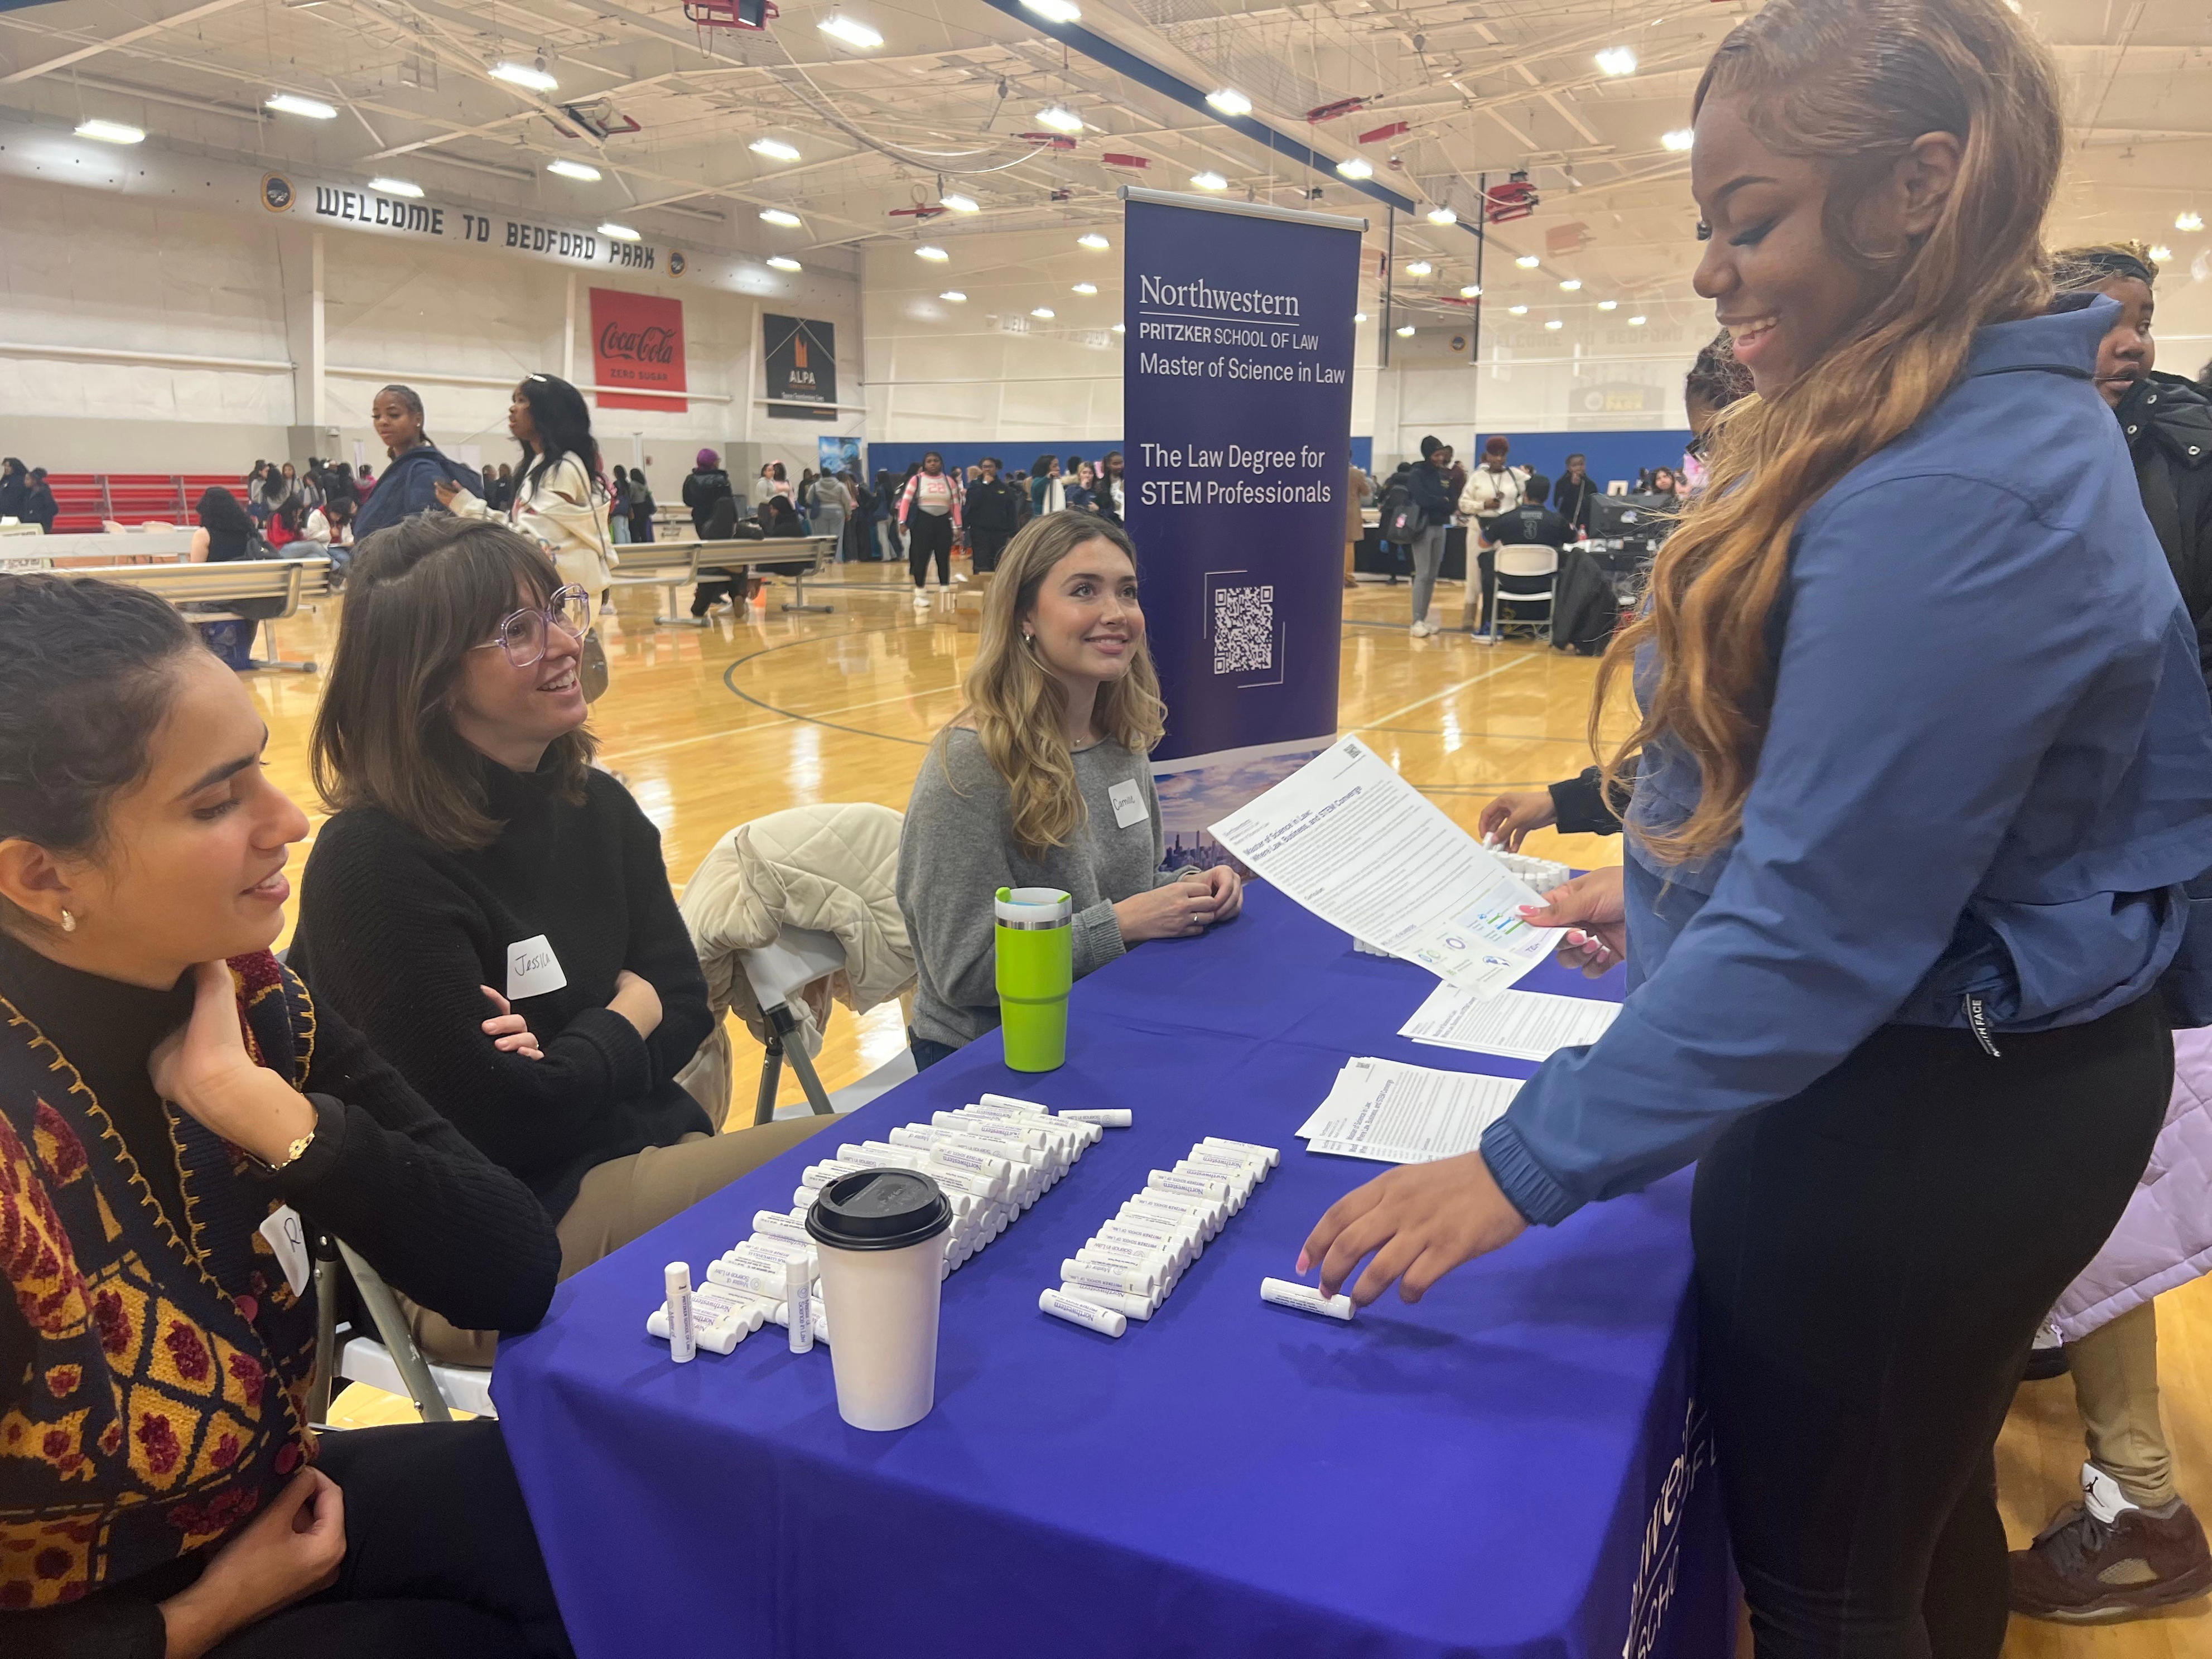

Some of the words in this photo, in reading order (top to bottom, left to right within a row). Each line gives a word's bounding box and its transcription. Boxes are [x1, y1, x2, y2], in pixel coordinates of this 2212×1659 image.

[316, 186, 444, 235] WELCOME
[462, 214, 491, 243] TO
[506, 221, 596, 261] BEDFORD
[609, 241, 655, 269] PARK
[1139, 275, 1300, 317] Northwestern
[1139, 322, 1212, 344] PRITZKER
[1214, 328, 1268, 348] SCHOOL
[1270, 332, 1290, 349] OF
[1292, 334, 1319, 351] LAW
[610, 369, 635, 379] ZERO
[639, 371, 668, 382] SUGAR
[789, 370, 816, 385] ALPA
[1140, 352, 1204, 378] Master
[1208, 356, 1225, 378] of
[1228, 358, 1293, 382] Science
[1298, 361, 1312, 383] in
[1315, 363, 1346, 384] Law
[1140, 442, 1182, 468] The
[1188, 443, 1224, 468] Law
[1228, 444, 1295, 475] Degree
[1300, 445, 1326, 469] for
[1141, 480, 1202, 505] STEM
[1207, 480, 1332, 504] Professionals
[943, 1155, 982, 1171] Northwestern
[1203, 1156, 1241, 1169] Northwestern
[1163, 1181, 1203, 1195] Northwestern
[1080, 1285, 1125, 1298] Northwestern
[1054, 1301, 1095, 1322] Northwestern
